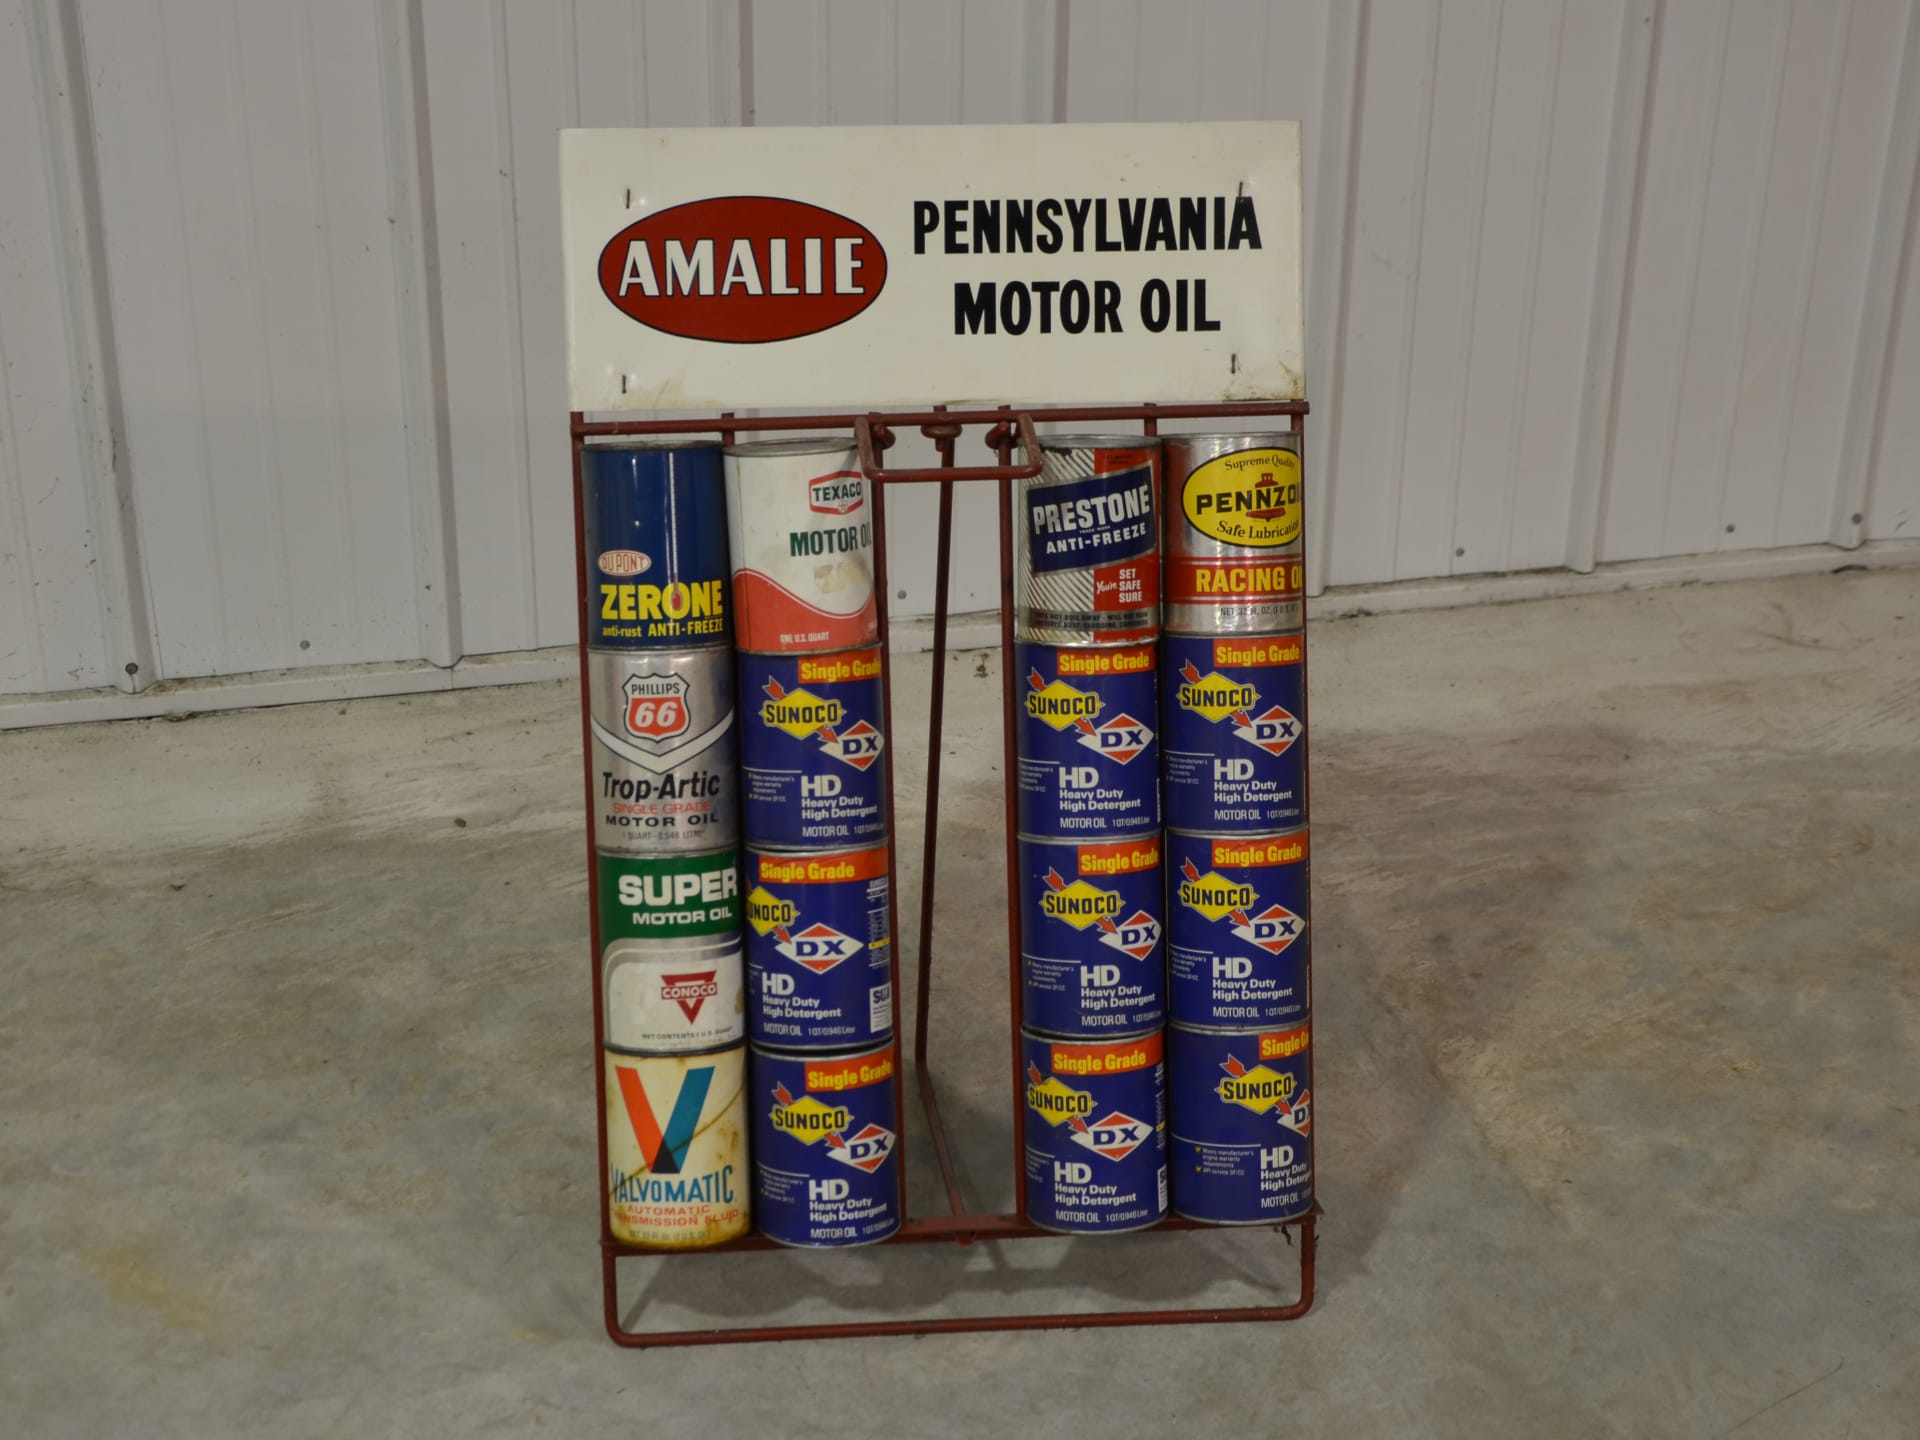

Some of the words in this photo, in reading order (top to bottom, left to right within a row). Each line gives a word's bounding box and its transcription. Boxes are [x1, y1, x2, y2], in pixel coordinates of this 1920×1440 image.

[913, 196, 1262, 254] PENNSYLVANIA
[617, 237, 866, 297] AMALIE
[954, 280, 1123, 336] MOTOR
[1140, 279, 1221, 333] OIL
[1224, 456, 1270, 471] Supreme
[1271, 454, 1295, 470] Quality
[812, 481, 862, 502] TEXACO
[1033, 484, 1150, 535] PRESTONE
[1046, 522, 1146, 554] ANTI-FREEZE
[1217, 520, 1245, 538] Safe
[789, 525, 858, 557] MOTOR
[1119, 568, 1136, 580] SET
[1196, 566, 1286, 593] RACING
[1119, 580, 1141, 591] SAFE
[600, 580, 723, 620] ZERONE
[1119, 591, 1142, 603] SURE
[602, 625, 642, 637] anti-rust
[1059, 655, 1110, 675] Single
[1112, 652, 1150, 670] Grade
[1216, 647, 1266, 666] Single
[1269, 644, 1300, 662] Grade
[801, 662, 850, 683] Single
[631, 683, 680, 696] PHILLIPS
[1181, 687, 1253, 707] SUNOCO
[635, 701, 678, 728] 66
[765, 703, 838, 724] SUNOCO
[1029, 695, 1097, 715] SUNOCO
[1101, 729, 1145, 748] DX
[1256, 721, 1295, 740] DX
[843, 735, 879, 756] DX
[1059, 767, 1100, 789] HD
[1213, 758, 1255, 781] HD
[603, 770, 720, 803] Trop-Artic
[800, 774, 842, 798] HD
[1059, 789, 1094, 801] Heavy
[1096, 789, 1123, 800] Duty
[1214, 781, 1250, 793] Heavy
[1251, 780, 1278, 791] Duty
[662, 800, 712, 814] GRADE
[801, 797, 837, 811] Heavy
[839, 796, 864, 807] Duty
[1059, 801, 1086, 813] High
[1088, 799, 1141, 811] Detergent
[1214, 792, 1241, 805] High
[1243, 790, 1292, 803] Detergent
[606, 815, 676, 827] MOTOR
[688, 813, 719, 825] OIL
[801, 809, 830, 822] High
[831, 805, 878, 820] Detergent
[1060, 817, 1093, 829] MOTOR
[1093, 817, 1106, 829] OIL
[1214, 809, 1247, 821] MOTOR
[1248, 808, 1262, 820] OIL
[802, 826, 835, 838] MOTOR
[836, 825, 849, 836] OIL
[1081, 854, 1130, 874] Single
[1131, 848, 1158, 868] Grade
[1214, 847, 1264, 867] Single
[1267, 843, 1302, 862] Grade
[760, 862, 805, 883] Single
[807, 862, 855, 880] Grade
[618, 867, 738, 907] SUPER
[1182, 884, 1251, 907] SUNOCO
[749, 903, 792, 923] UNOCO
[1046, 894, 1117, 915] SUNOCO
[632, 910, 706, 925] MOTOR
[709, 906, 733, 921] OIL
[1121, 925, 1157, 946] DX
[1254, 919, 1297, 939] DX
[795, 940, 846, 957] DX
[1080, 965, 1120, 987] HD
[1212, 956, 1253, 979] HD
[662, 984, 717, 999] CONOCO
[762, 972, 795, 996] HD
[1081, 987, 1116, 1000] Heavy
[1118, 985, 1142, 996] Duty
[1212, 979, 1248, 991] Heavy
[1249, 978, 1276, 990] Duty
[763, 995, 791, 1008] Heavy
[792, 997, 820, 1008] Duty
[1081, 999, 1108, 1011] High
[1110, 993, 1156, 1009] Detergent
[1212, 989, 1239, 1002] High
[1241, 987, 1293, 1001] Detergent
[763, 1007, 783, 1019] High
[784, 1008, 842, 1020] Detergent
[1081, 1015, 1115, 1027] MOTOR
[1115, 1014, 1128, 1025] OIL
[1213, 1006, 1246, 1018] MOTOR
[1246, 1005, 1260, 1018] OIL
[763, 1022, 789, 1035] MOTOR
[790, 1024, 803, 1037] OIL
[1262, 1038, 1300, 1057] Single
[1054, 1054, 1102, 1075] Single
[1104, 1050, 1146, 1070] Grade
[808, 1071, 858, 1091] Single
[860, 1061, 891, 1082] Grade
[1223, 1077, 1292, 1100] SUNOCO
[1028, 1087, 1088, 1114] SUNOCO
[774, 1108, 845, 1130] SUNOCO
[1093, 1125, 1140, 1145] DX
[850, 1135, 889, 1160] DX
[1260, 1145, 1294, 1170] HD
[1053, 1161, 1092, 1184] HD
[1260, 1167, 1291, 1180] Heavy
[610, 1163, 734, 1205] VALVOMATIC
[808, 1179, 850, 1201] HD
[1055, 1183, 1087, 1195] Heavy
[1089, 1185, 1117, 1196] Duty
[1260, 1178, 1285, 1192] High
[627, 1204, 711, 1216] AUTOMATIC
[809, 1201, 845, 1212] Heavy
[846, 1198, 873, 1209] Duty
[1055, 1193, 1080, 1206] High
[1081, 1193, 1137, 1207] Detergent
[1261, 1195, 1290, 1209] MOTOR
[1290, 1194, 1299, 1205] OIL
[809, 1211, 837, 1224] High
[838, 1203, 887, 1221] Detergent
[1055, 1210, 1085, 1222] MOTOR
[1086, 1211, 1100, 1223] OIL
[810, 1227, 844, 1239] MOTOR
[844, 1226, 858, 1238] OIL
